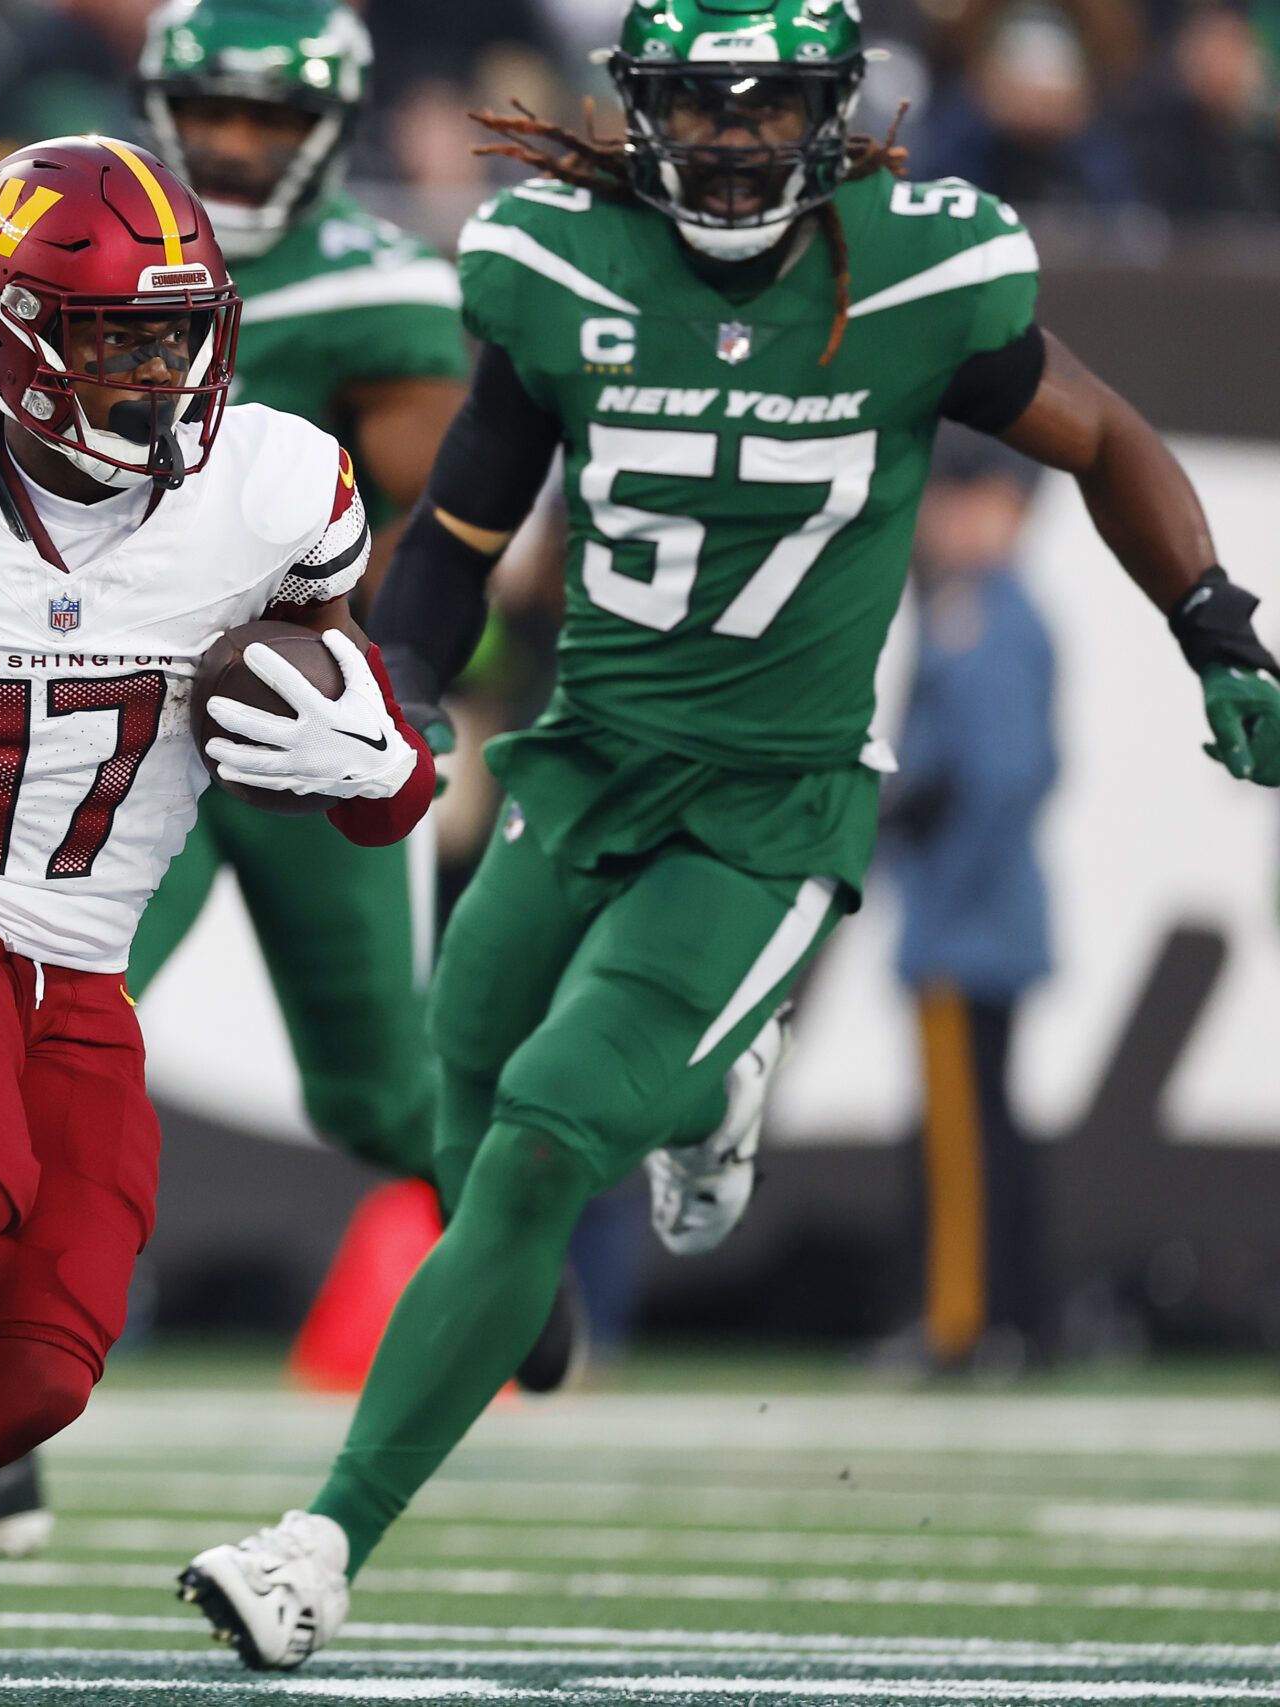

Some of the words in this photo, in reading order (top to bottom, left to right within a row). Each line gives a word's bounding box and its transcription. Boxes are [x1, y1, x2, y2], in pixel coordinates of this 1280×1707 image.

[580, 317, 636, 365] C
[596, 385, 719, 417] NEW
[724, 389, 871, 424] YORK
[579, 422, 877, 640] 57
[53, 612, 77, 628] NFL
